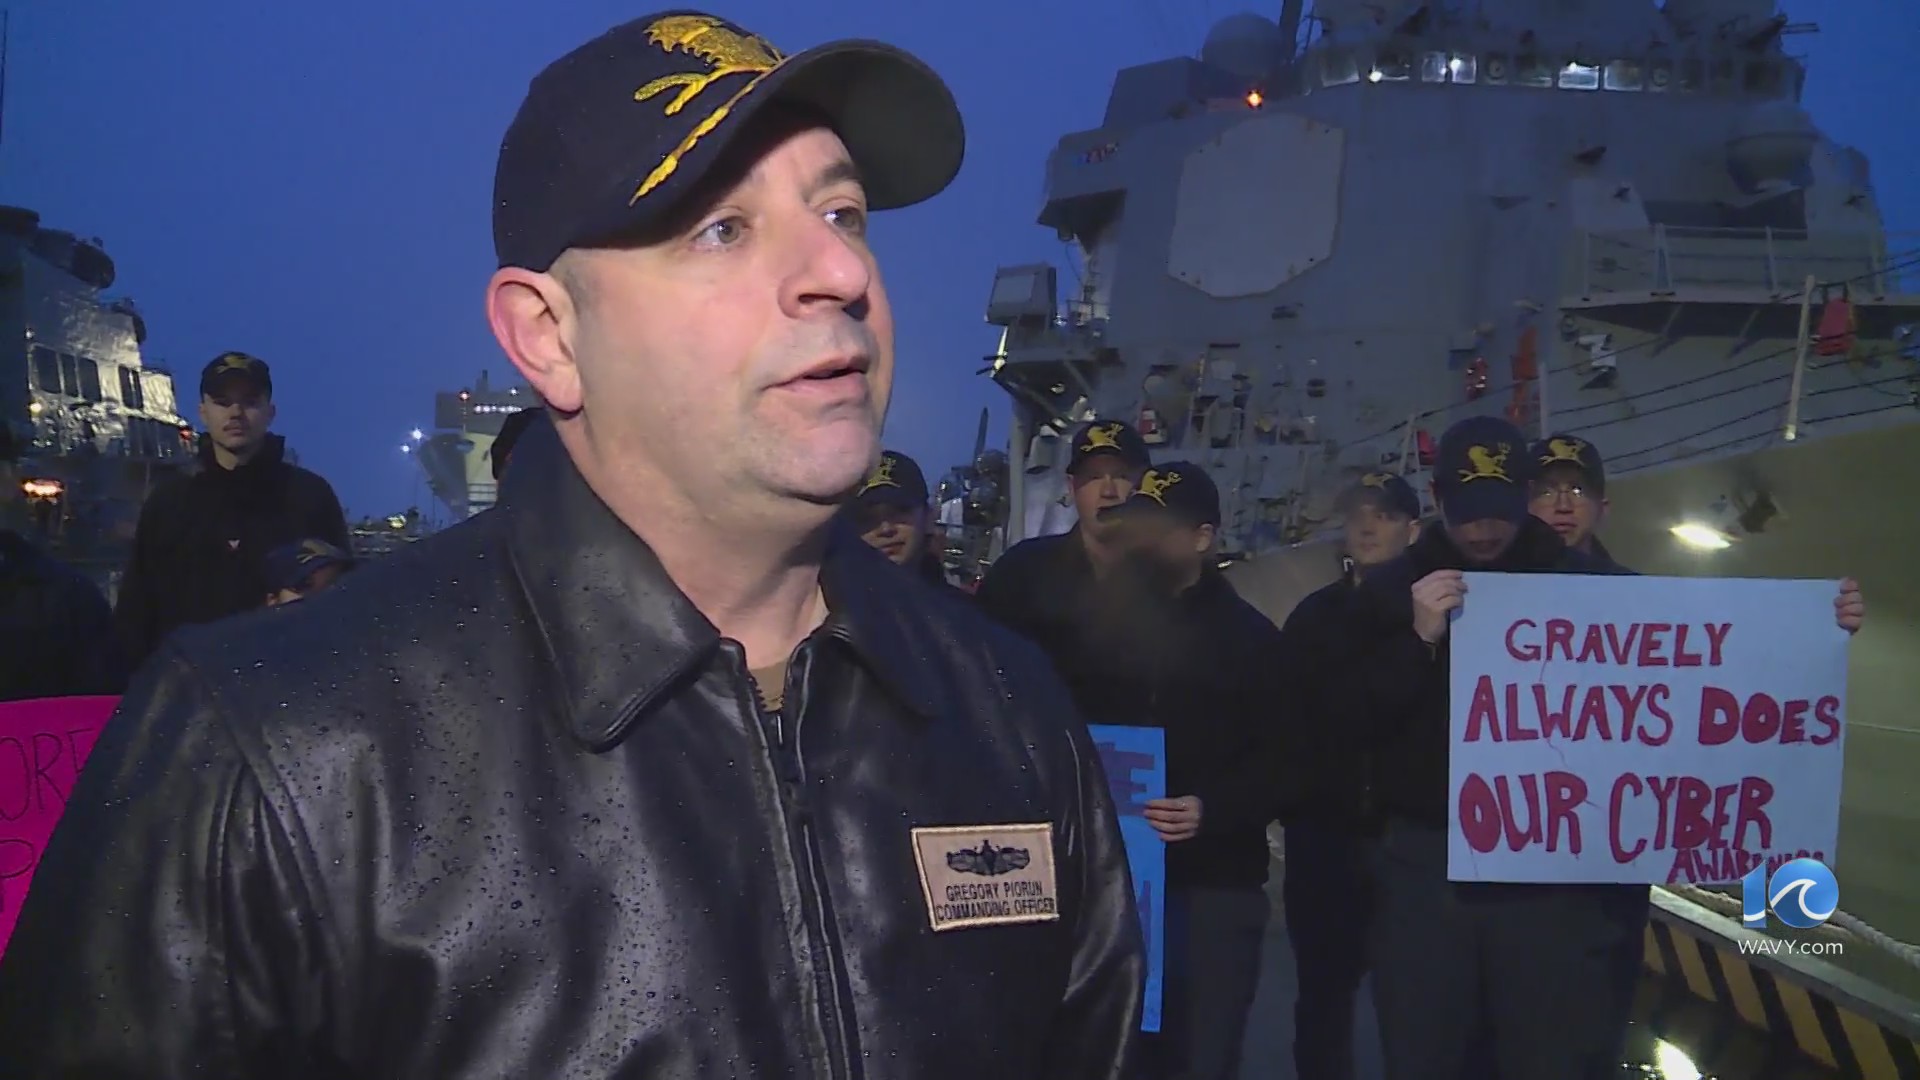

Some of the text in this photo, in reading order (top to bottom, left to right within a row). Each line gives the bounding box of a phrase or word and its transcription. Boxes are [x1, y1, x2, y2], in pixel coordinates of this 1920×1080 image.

[1505, 618, 1732, 667] GRAVELY
[1463, 675, 1840, 747] ALWAYS DOES
[1459, 771, 1774, 864] OUR CYBER
[1666, 849, 1825, 884] AWARN
[936, 897, 1054, 921] COMMANDING OFFICER
[945, 880, 1043, 902] GREGORY PIORUN
